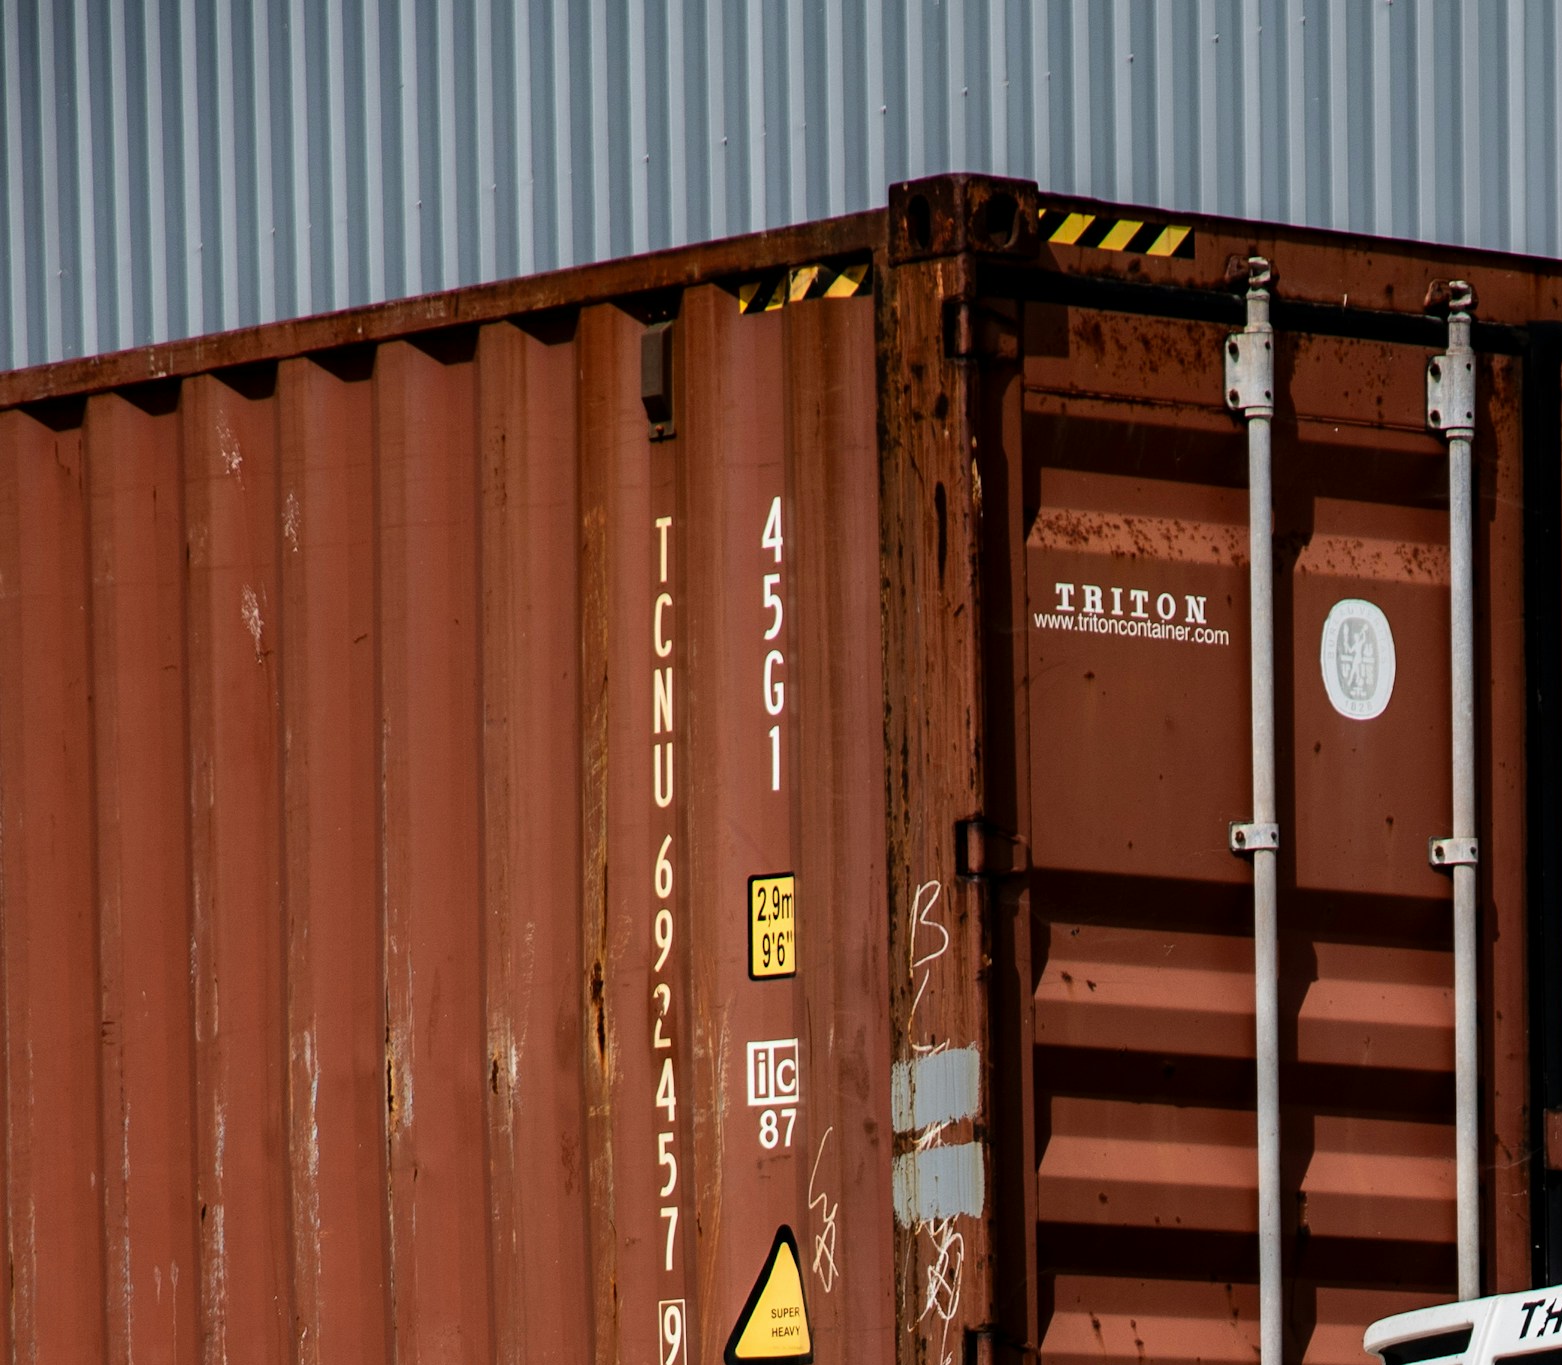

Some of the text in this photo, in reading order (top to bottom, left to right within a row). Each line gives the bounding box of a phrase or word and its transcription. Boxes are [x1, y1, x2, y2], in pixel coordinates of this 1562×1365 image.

[1055, 583, 1208, 624] TRITON
[762, 496, 785, 792] 45G1
[1034, 612, 1230, 645] www.tritoncontainer.com
[653, 516, 674, 809] TCNU
[653, 833, 680, 1272] 692457
[758, 1108, 798, 1150] 87
[771, 1306, 801, 1320] SUPER
[771, 1325, 801, 1338] HEAVY
